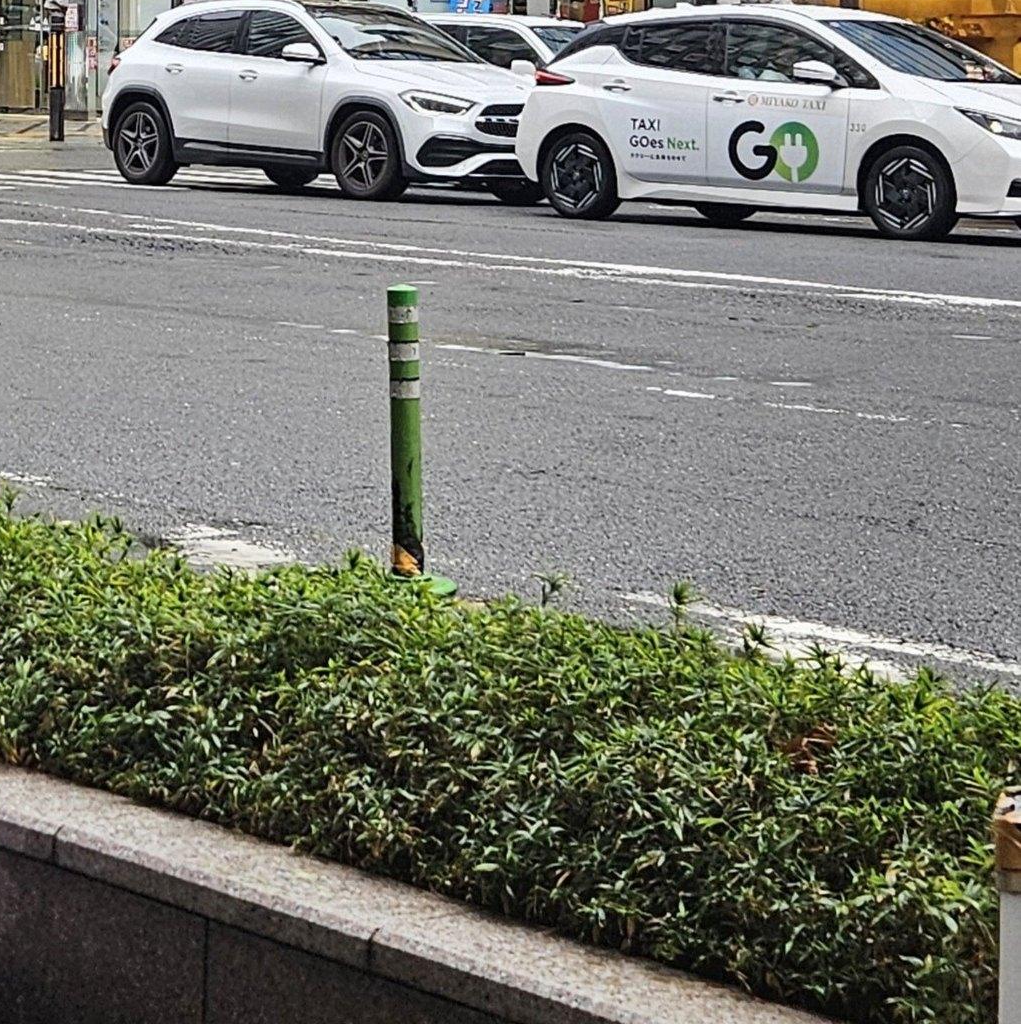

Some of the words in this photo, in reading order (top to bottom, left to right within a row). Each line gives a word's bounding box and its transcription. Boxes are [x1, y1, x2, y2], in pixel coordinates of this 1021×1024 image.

[761, 96, 798, 108] MIYAKO
[802, 100, 826, 111] TAXI
[630, 118, 660, 131] TAXI
[629, 135, 664, 149] GOes
[667, 137, 699, 151] Next.
